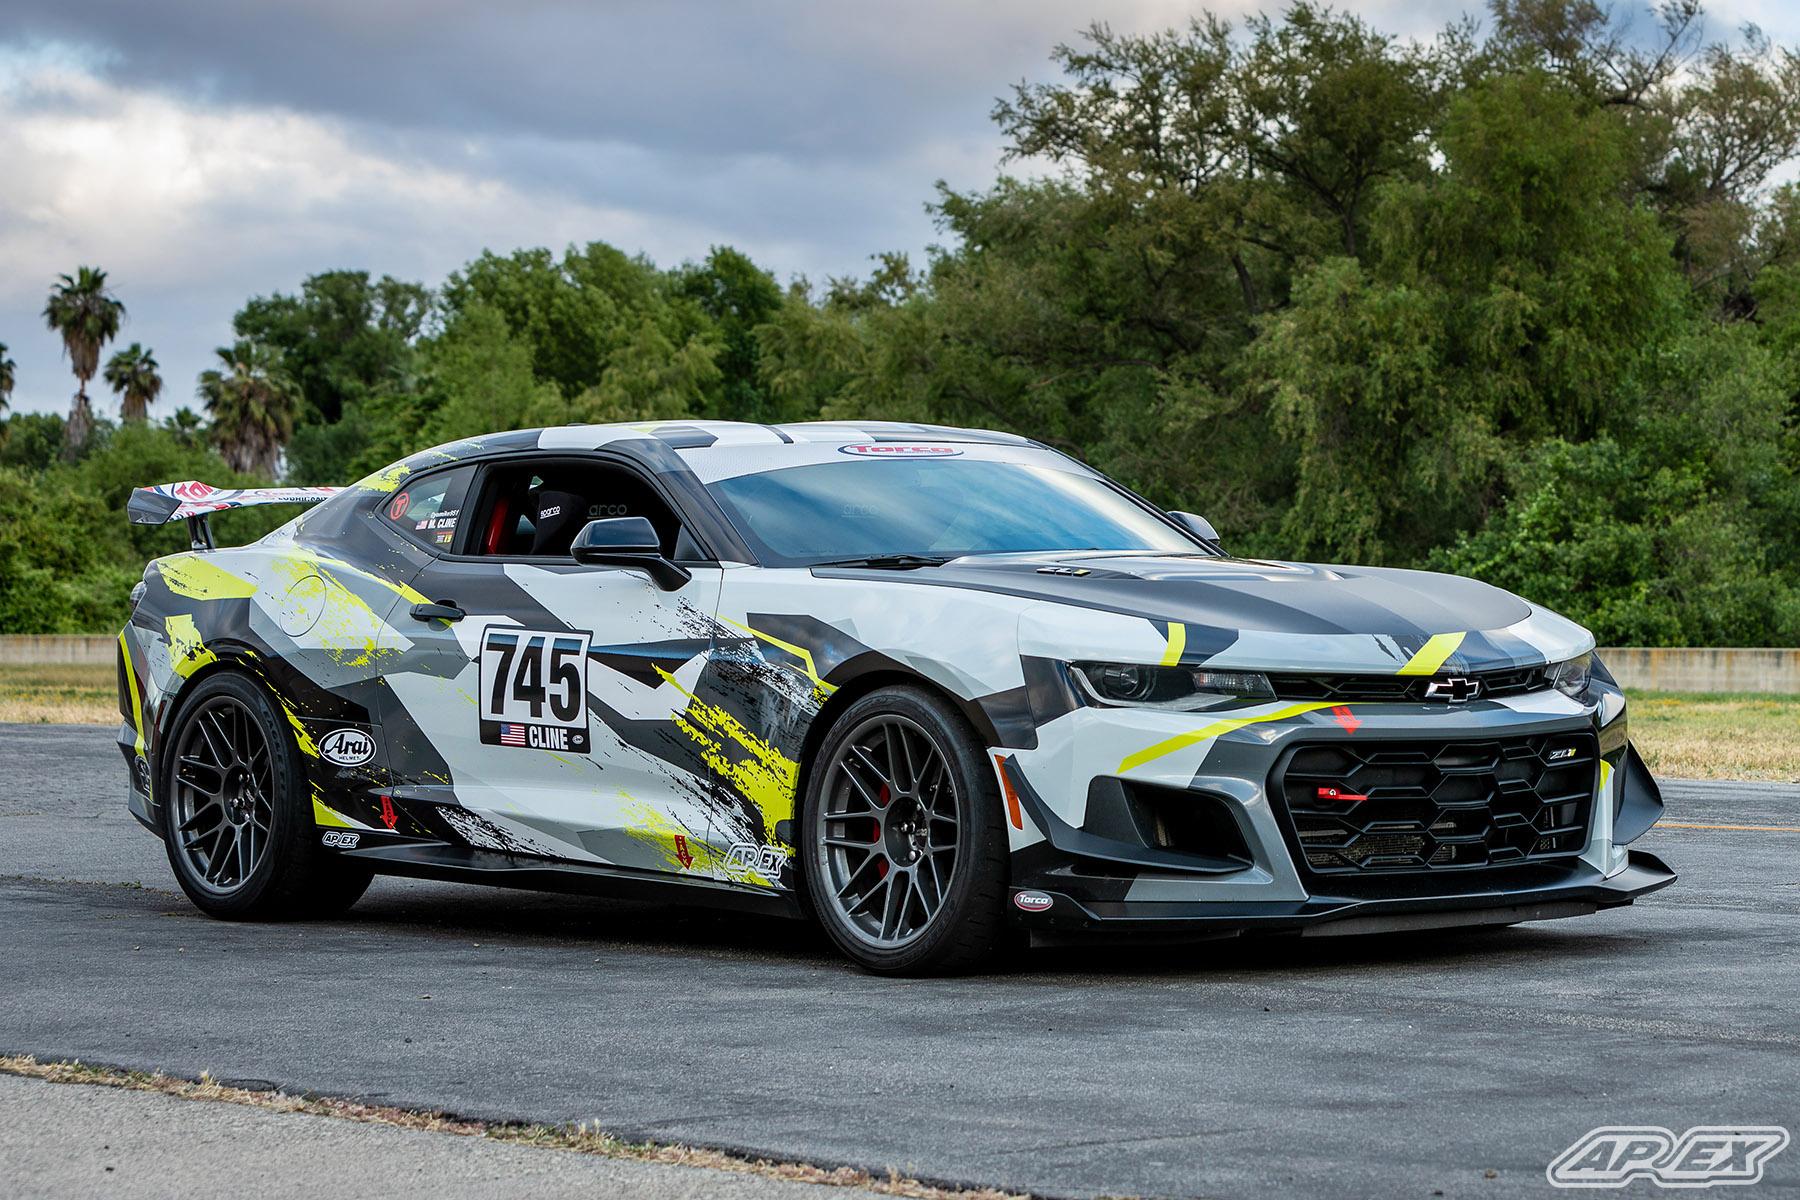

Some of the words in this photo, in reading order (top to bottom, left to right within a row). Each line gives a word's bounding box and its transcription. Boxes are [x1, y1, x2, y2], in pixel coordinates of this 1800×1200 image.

[849, 445, 954, 453] Torco
[540, 506, 560, 517] sparco
[588, 504, 628, 516] arco
[437, 518, 457, 528] CLINE
[486, 633, 583, 722] 745
[528, 725, 569, 750] CLINE
[324, 734, 370, 755] Arai
[1020, 894, 1049, 904] Torco
